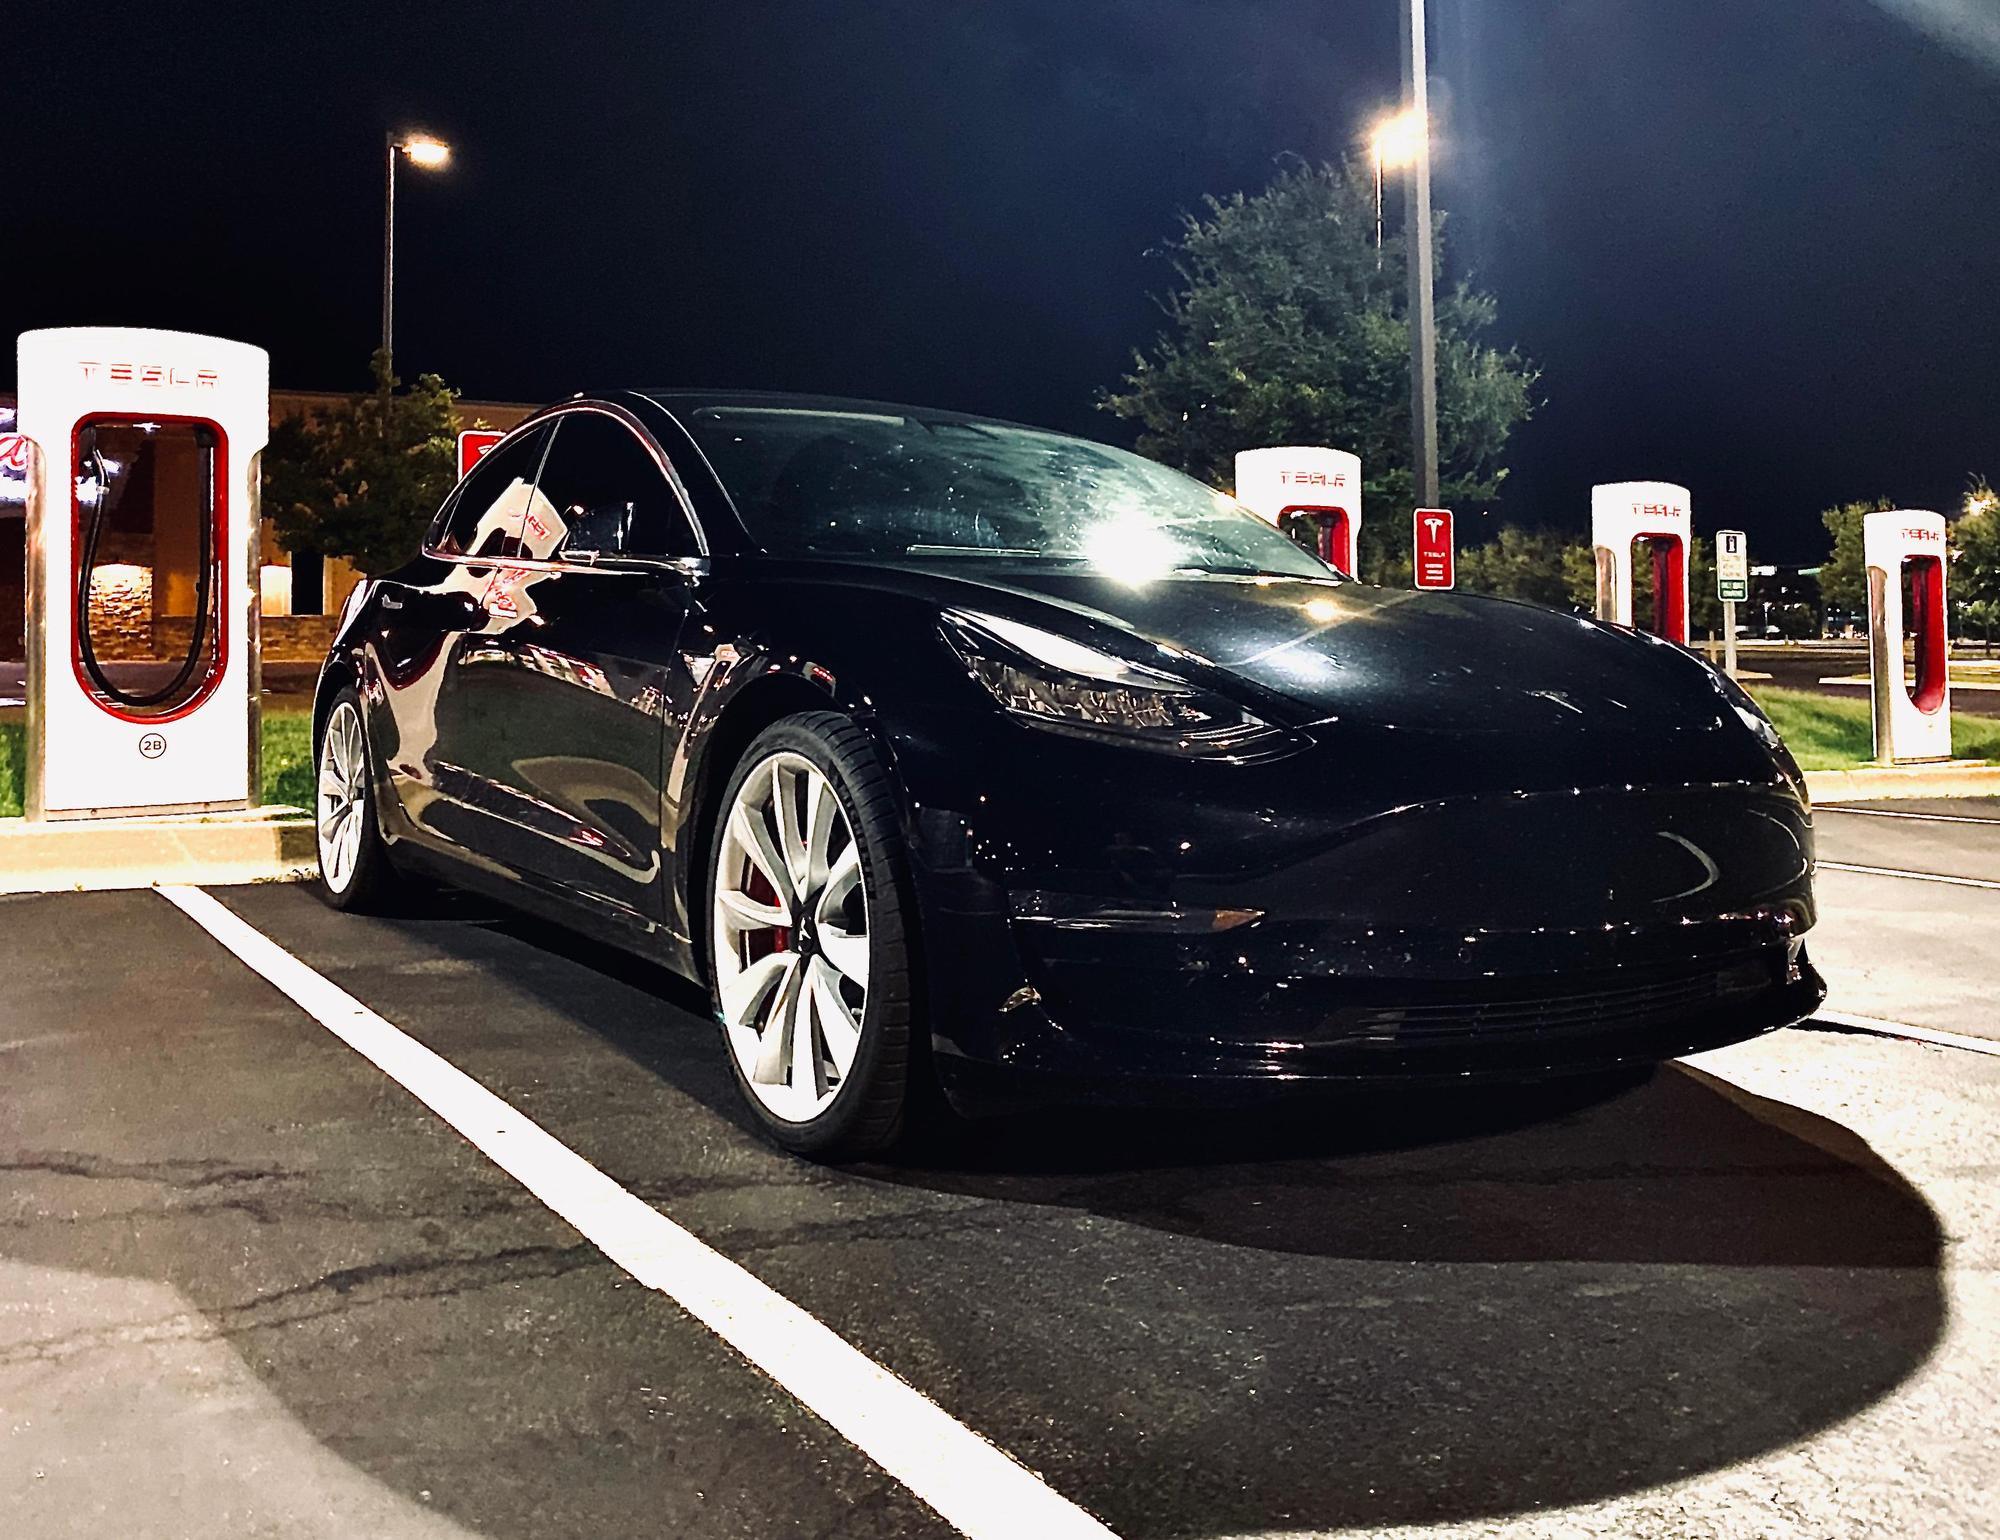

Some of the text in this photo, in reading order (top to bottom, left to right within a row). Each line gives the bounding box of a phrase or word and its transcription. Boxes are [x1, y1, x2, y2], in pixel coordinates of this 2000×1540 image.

[78, 360, 220, 390] TESLA
[1280, 470, 1346, 487] TESLA
[144, 740, 162, 751] 2B
